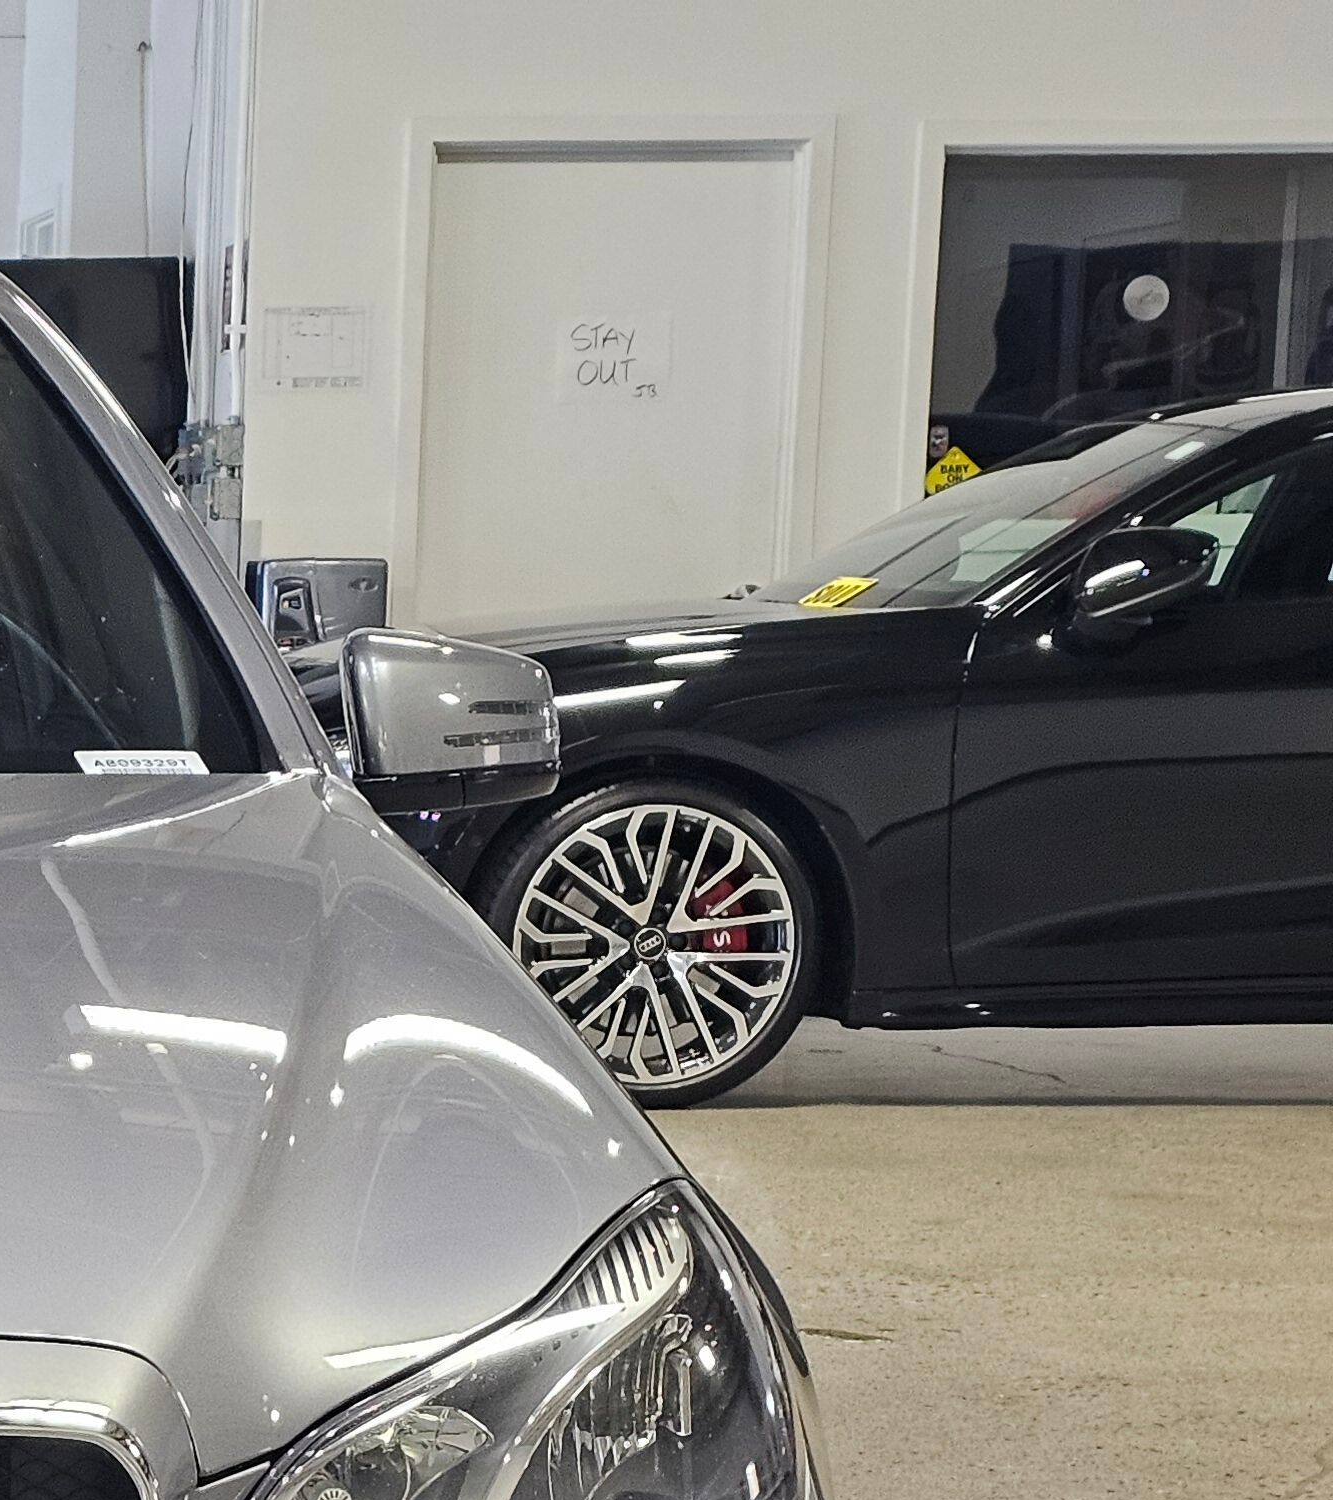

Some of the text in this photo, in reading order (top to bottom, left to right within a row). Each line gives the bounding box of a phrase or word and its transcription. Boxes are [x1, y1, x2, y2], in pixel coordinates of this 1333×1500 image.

[571, 323, 635, 355] STAY
[577, 359, 637, 386] OUT
[940, 464, 969, 474] BABY
[947, 474, 963, 483] ON
